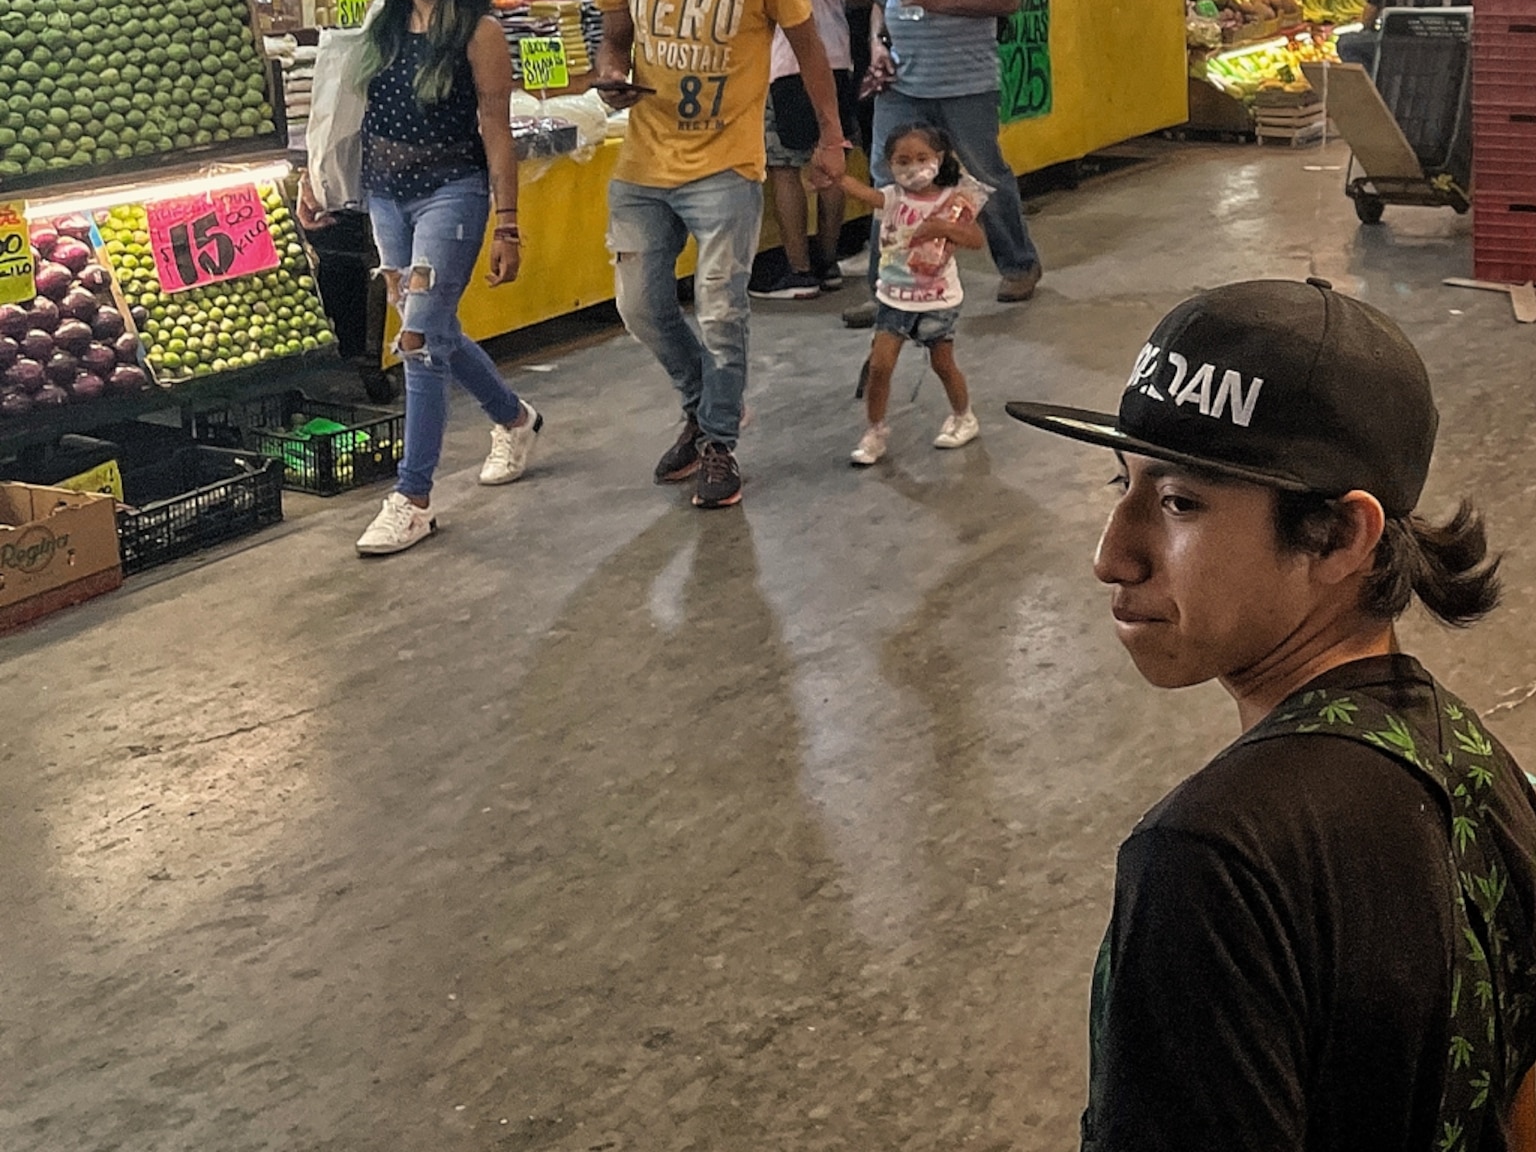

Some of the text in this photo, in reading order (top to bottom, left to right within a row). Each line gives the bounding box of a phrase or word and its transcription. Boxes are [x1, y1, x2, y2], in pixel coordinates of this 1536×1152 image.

[656, 40, 732, 74] POSTALE
[677, 75, 729, 120] 87
[170, 211, 235, 286] 15
[235, 219, 268, 256] KILO
